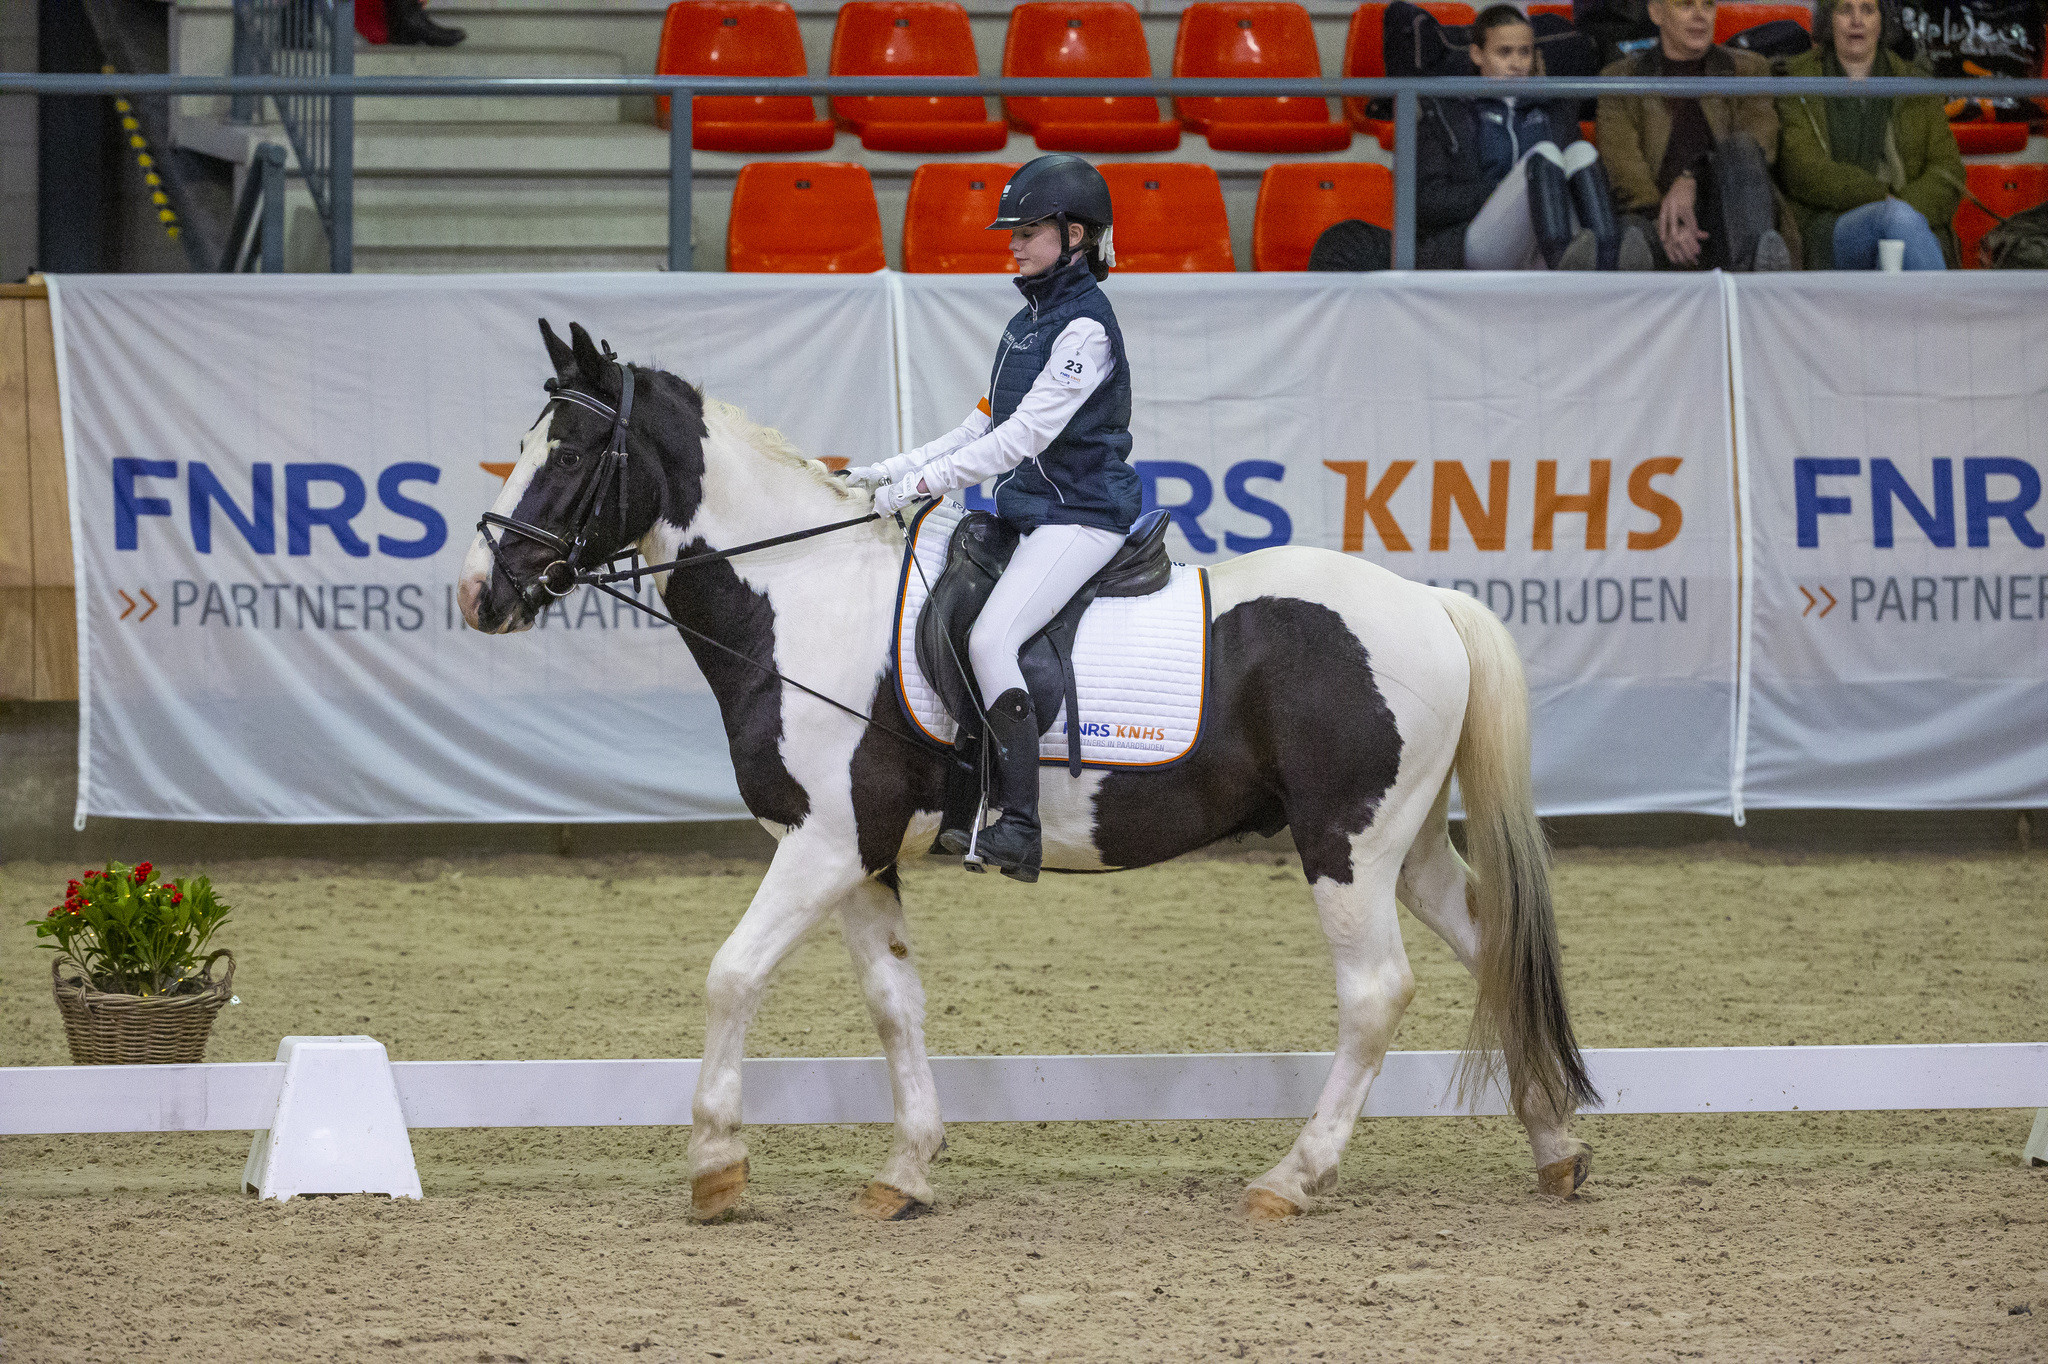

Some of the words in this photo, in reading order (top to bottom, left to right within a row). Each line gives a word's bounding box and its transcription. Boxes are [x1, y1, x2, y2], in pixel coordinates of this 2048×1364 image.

[1064, 360, 1083, 374] 23
[111, 456, 449, 559] FNRS
[1322, 456, 1684, 552] KNHS
[1793, 456, 2046, 549] FNR
[172, 580, 425, 631] PARTNERS
[1426, 576, 1687, 625] DRIJDEN
[1107, 740, 1115, 748] IN
[1115, 724, 1165, 741] KNHS
